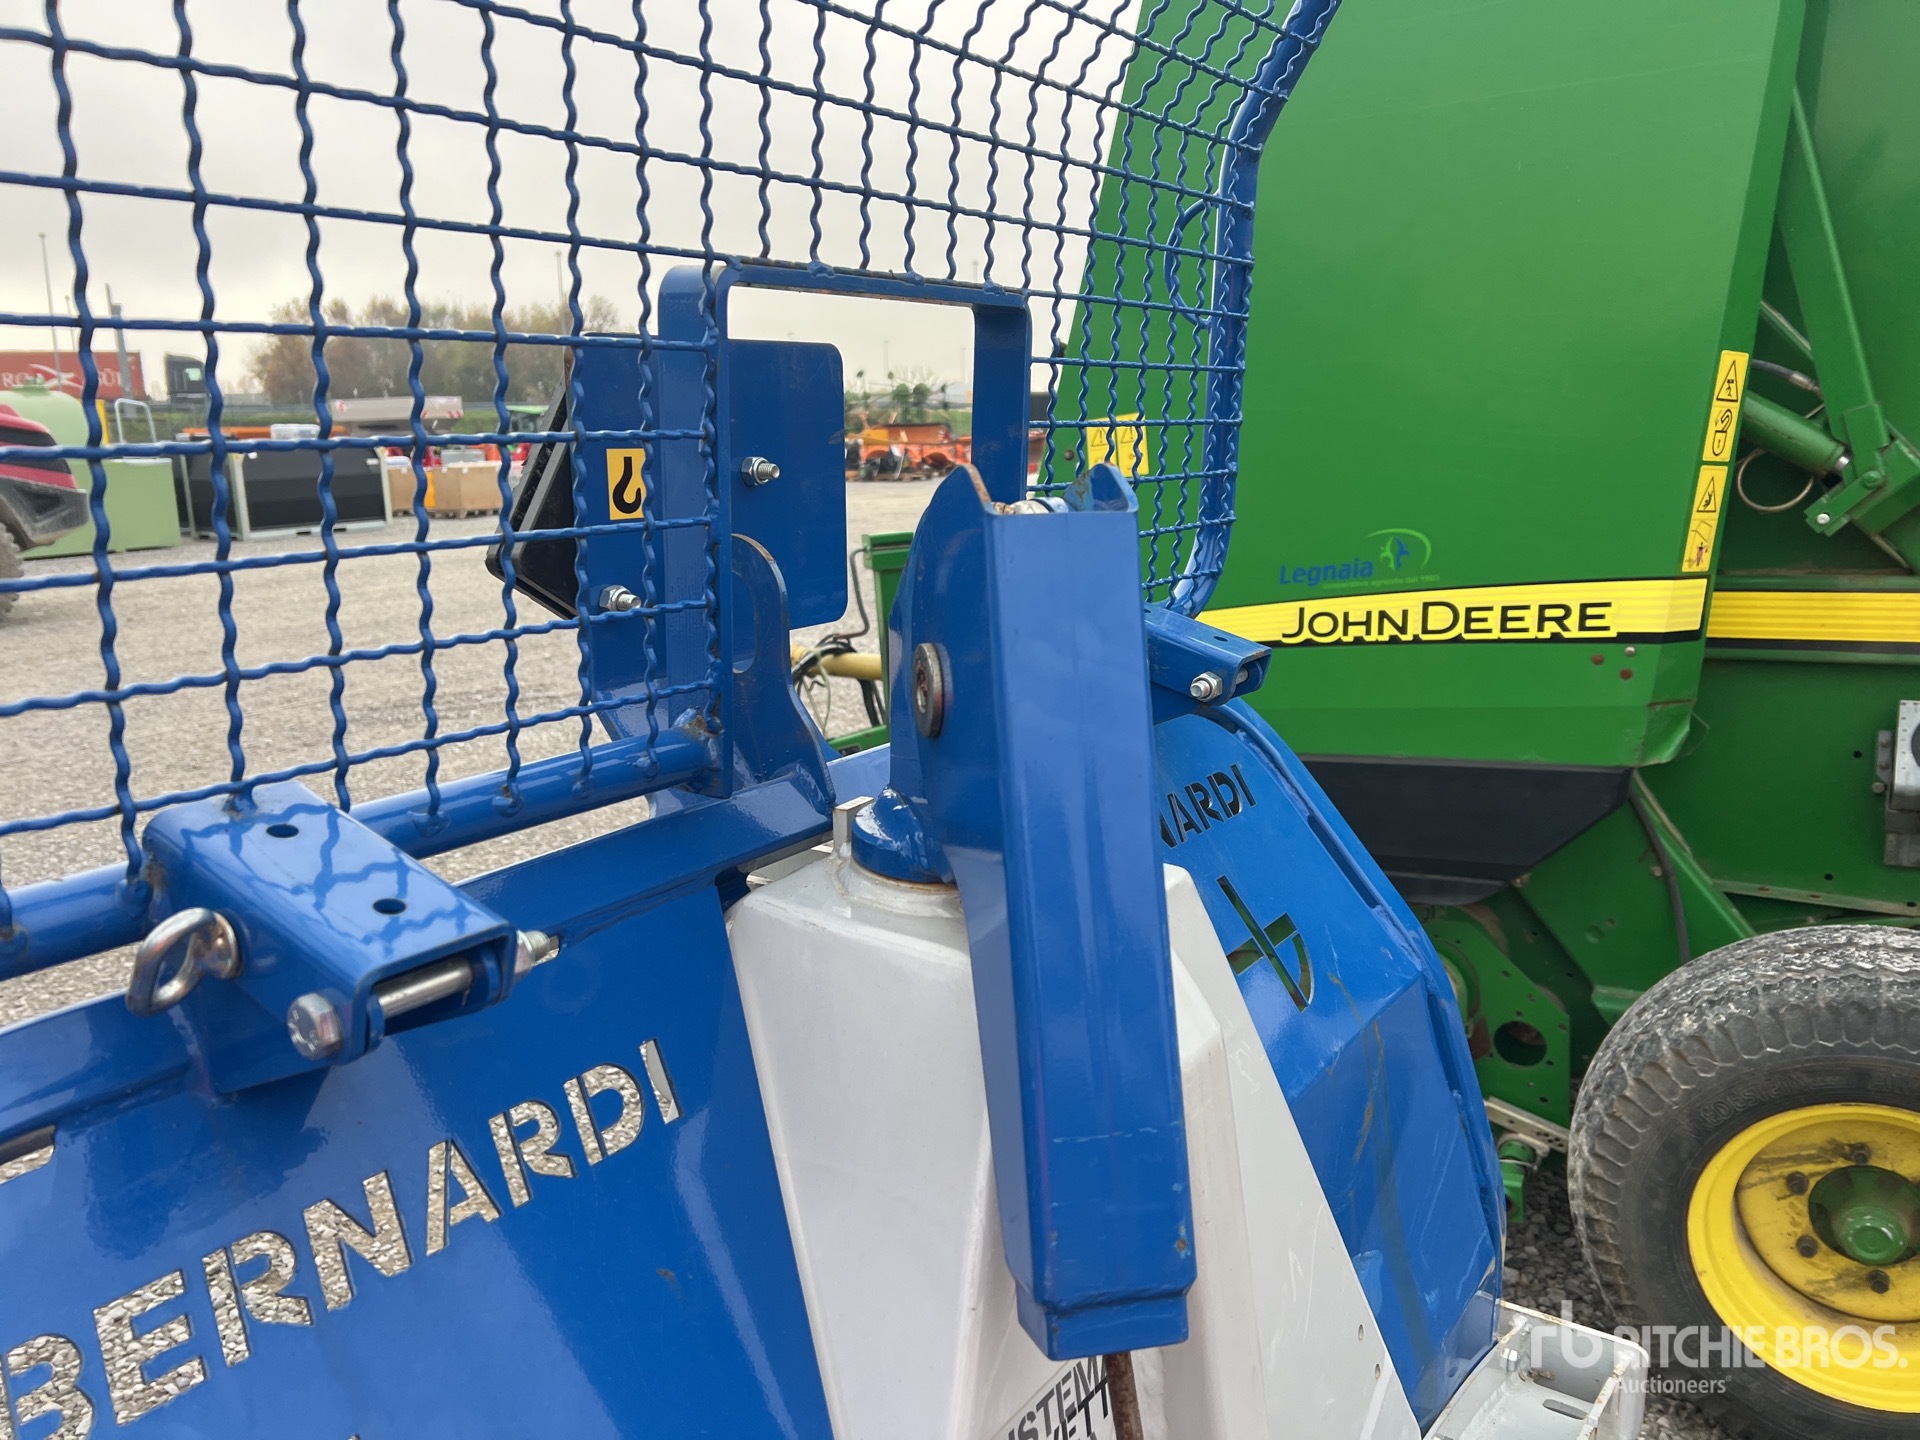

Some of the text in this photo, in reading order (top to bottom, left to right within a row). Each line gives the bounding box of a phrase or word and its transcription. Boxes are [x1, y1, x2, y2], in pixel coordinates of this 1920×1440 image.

[1280, 558, 1374, 587] Legnaia
[1281, 600, 1614, 640] JOHN DEERE
